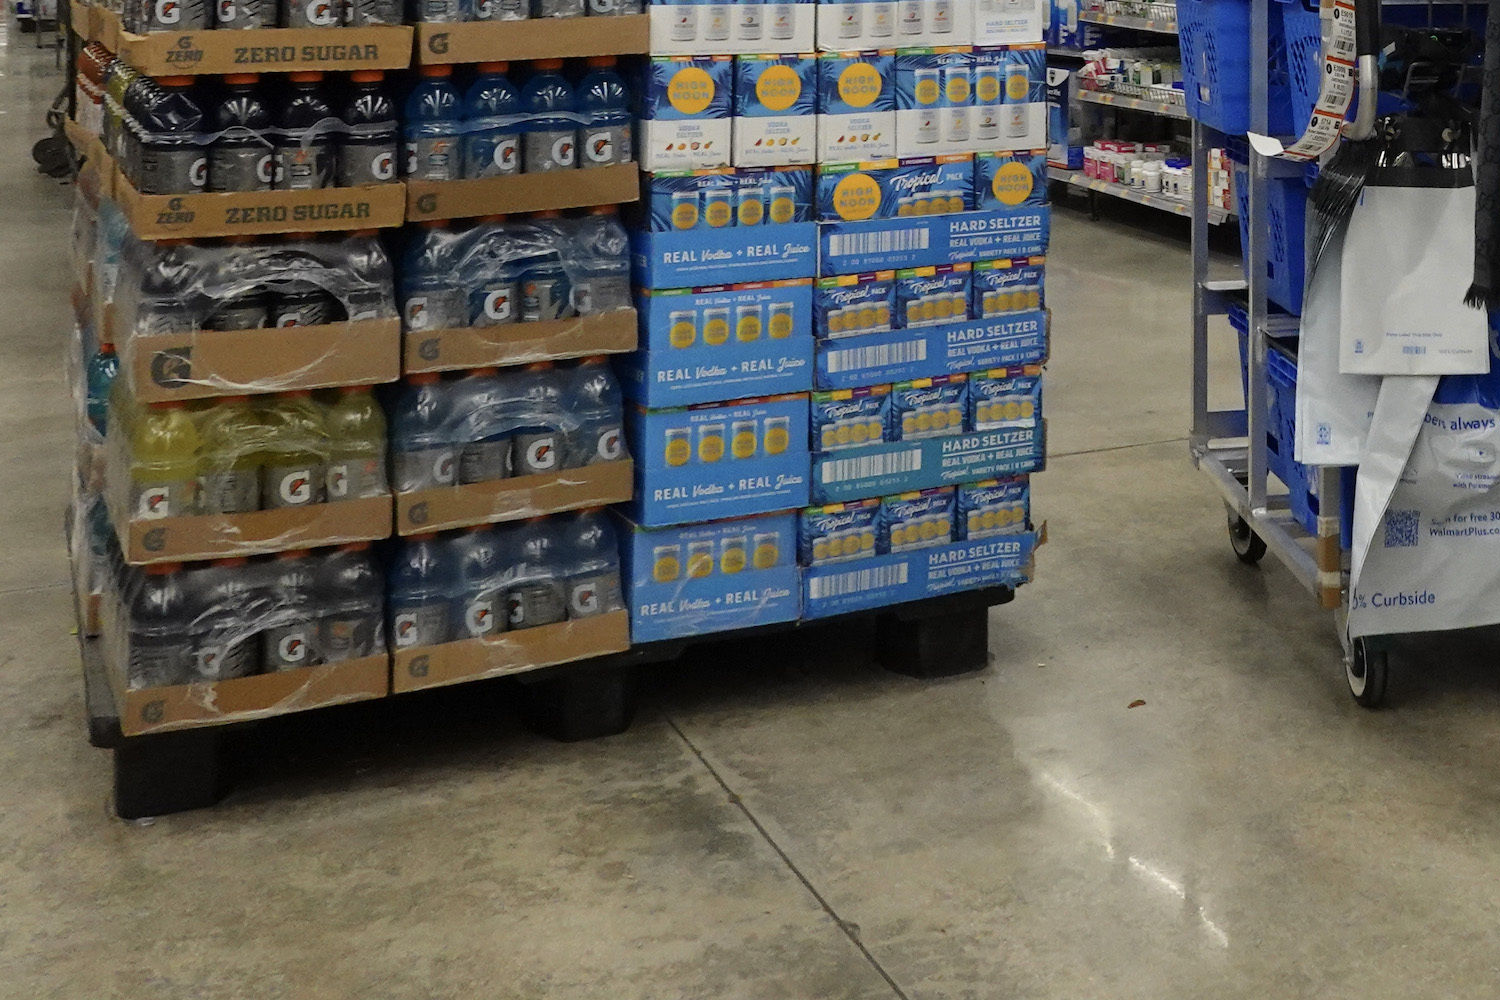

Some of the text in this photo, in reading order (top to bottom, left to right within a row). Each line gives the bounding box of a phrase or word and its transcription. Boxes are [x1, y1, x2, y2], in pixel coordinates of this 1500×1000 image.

[234, 43, 379, 63] ZERO SUGAR
[890, 167, 963, 192] Tropical PACK
[841, 188, 873, 197] HIGH
[225, 201, 371, 224] ZERO SUGAR
[950, 215, 1041, 233] HARD SELTZER
[949, 232, 1041, 248] REAL VODKA REAL JUICE
[663, 242, 811, 264] REAL Vodka REAL Juice
[910, 276, 948, 295] Tropical
[986, 269, 1024, 287] Tropical
[831, 285, 871, 304] Tropical
[947, 321, 1038, 342] HARD SELTZER
[947, 347, 966, 357] REAL
[657, 368, 691, 382] REAL
[695, 365, 727, 379] Vodka
[741, 358, 774, 373] REAL
[777, 357, 806, 372] Juice
[905, 387, 942, 406] Tropical
[980, 379, 1018, 397] Tropical
[824, 400, 864, 419] Tropical
[1451, 417, 1495, 432] always
[942, 430, 1033, 453] HARD SELTZER
[942, 458, 961, 467] REAL
[654, 488, 688, 502] REAL
[693, 484, 724, 498] Vodka
[739, 476, 771, 490] REAL
[774, 474, 803, 489] Juice
[1453, 514, 1467, 522] for
[1470, 513, 1487, 522] free
[928, 541, 1021, 565] HARD SELTZER
[640, 603, 674, 616] REAL
[726, 590, 758, 604] REAL
[1372, 590, 1436, 608] Curbside
